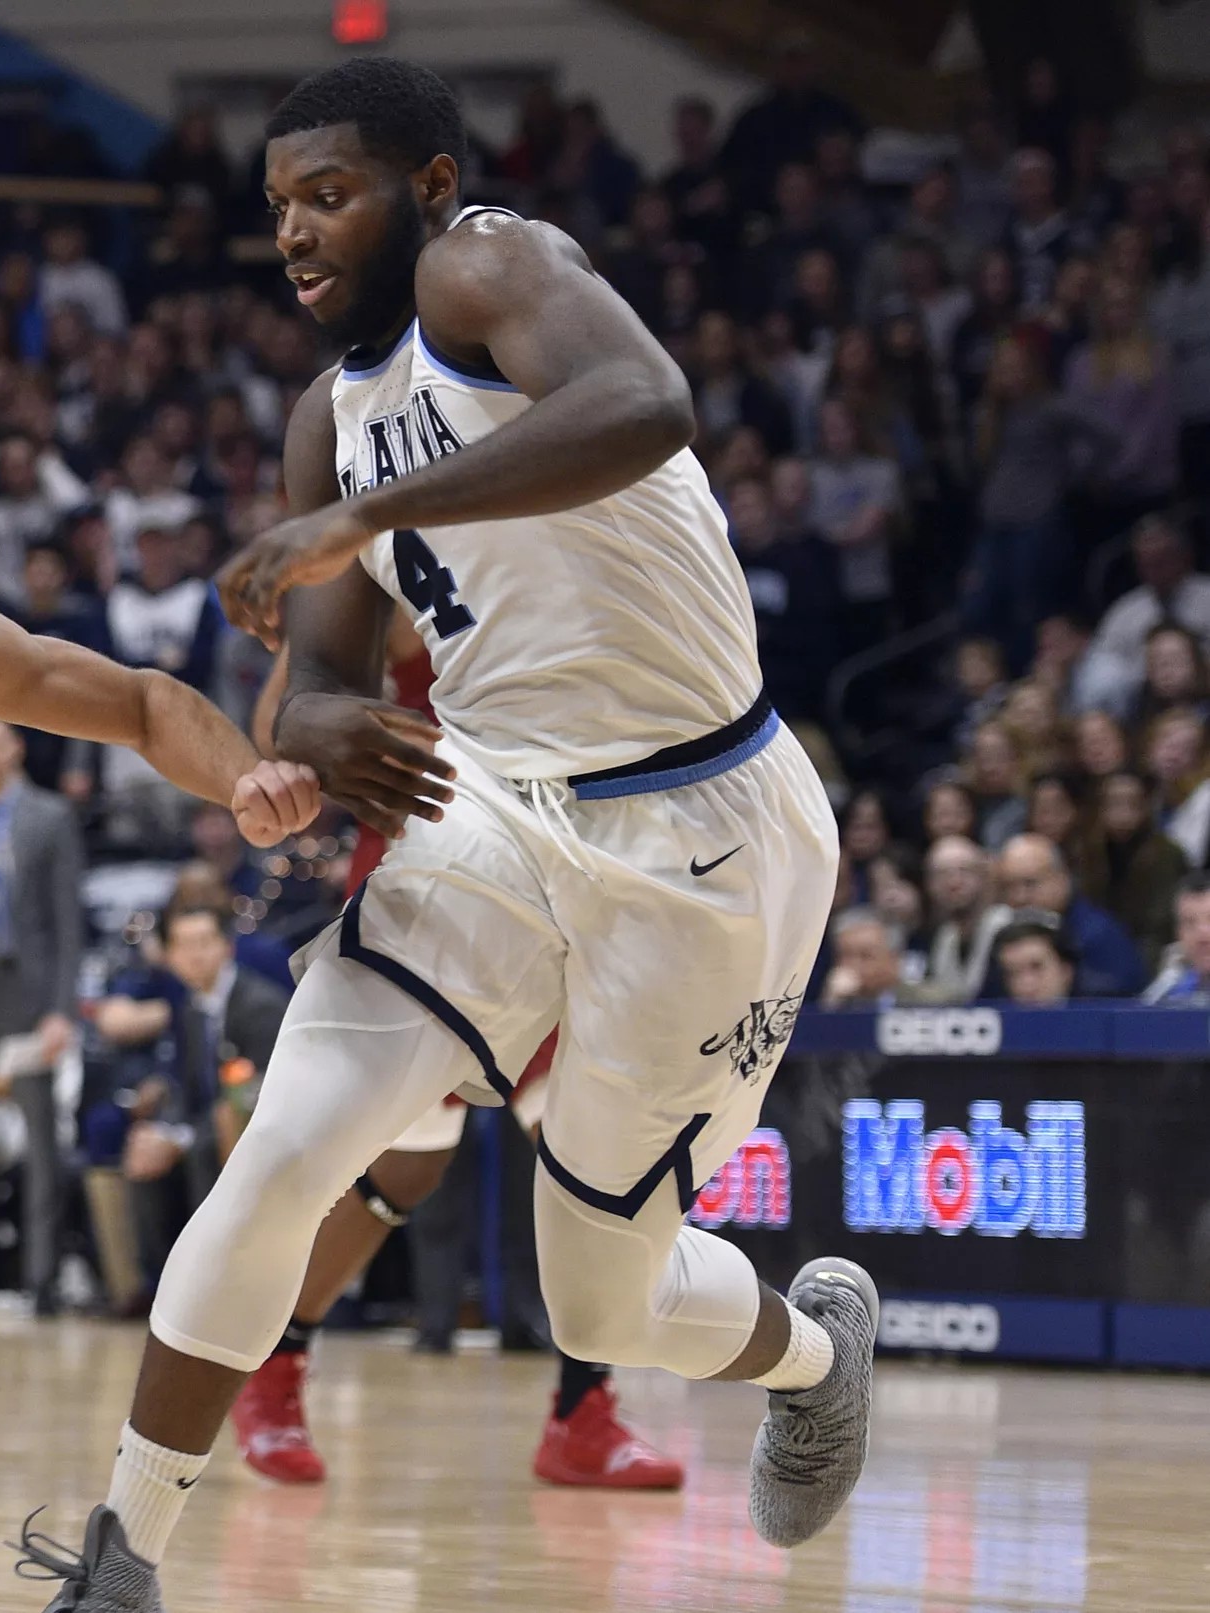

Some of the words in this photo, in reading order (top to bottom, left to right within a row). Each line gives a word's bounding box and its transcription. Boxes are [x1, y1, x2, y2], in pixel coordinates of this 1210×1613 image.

[392, 528, 478, 640] 4
[877, 1006, 1002, 1056] GEICO
[842, 1097, 1087, 1239] Mobil
[878, 1300, 1001, 1351] GEICO
